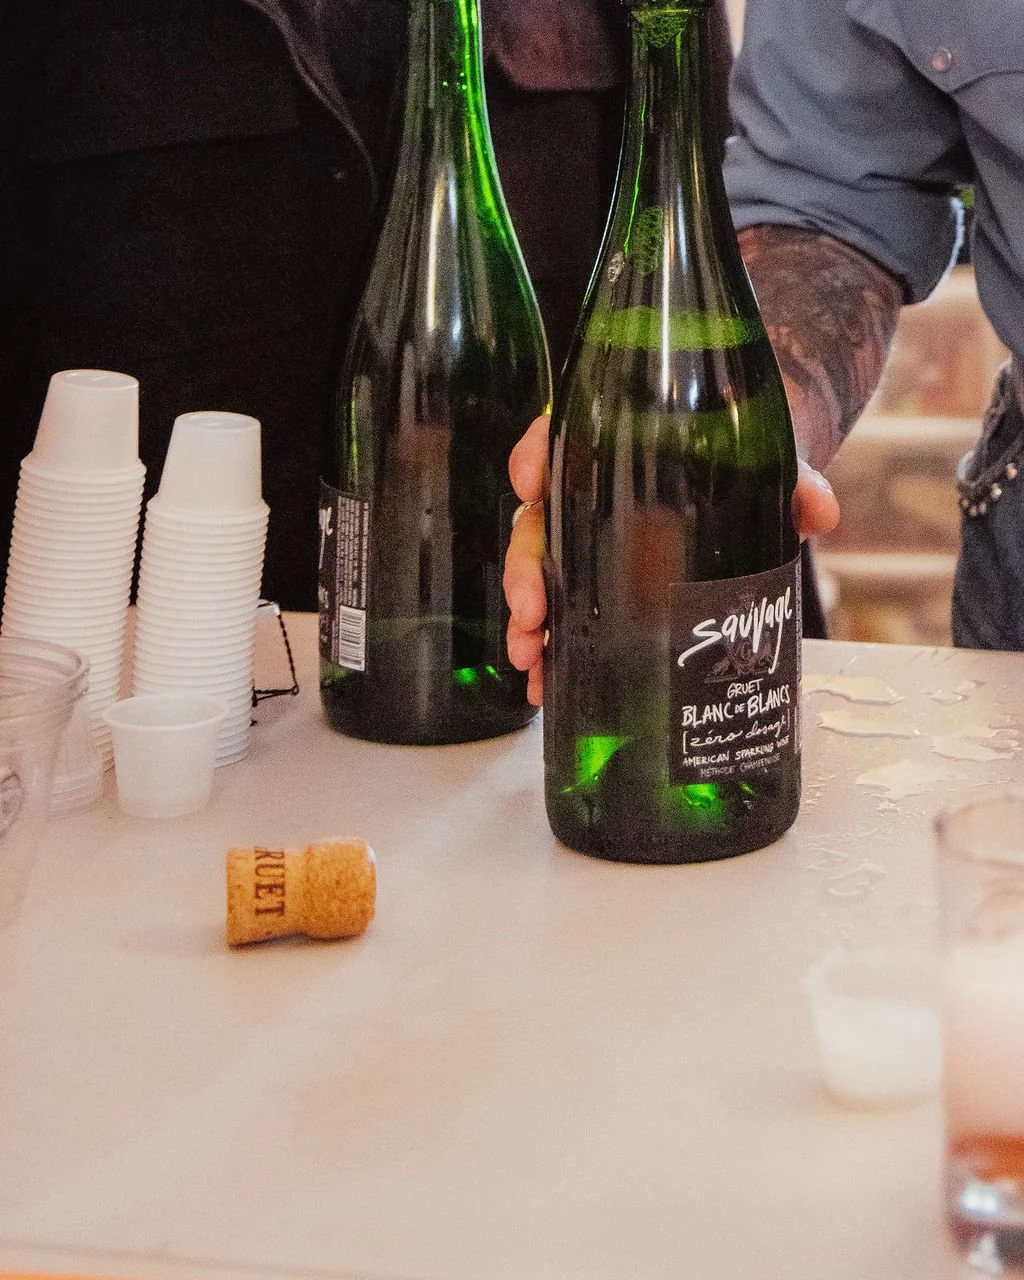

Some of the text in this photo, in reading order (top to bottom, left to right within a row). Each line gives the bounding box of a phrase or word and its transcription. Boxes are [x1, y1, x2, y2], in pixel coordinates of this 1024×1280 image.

[727, 677, 764, 699] GRUET
[681, 685, 791, 728] BLANC DE BLANCS
[682, 751, 730, 767] AMERICAN
[735, 742, 774, 761] SPARKLING
